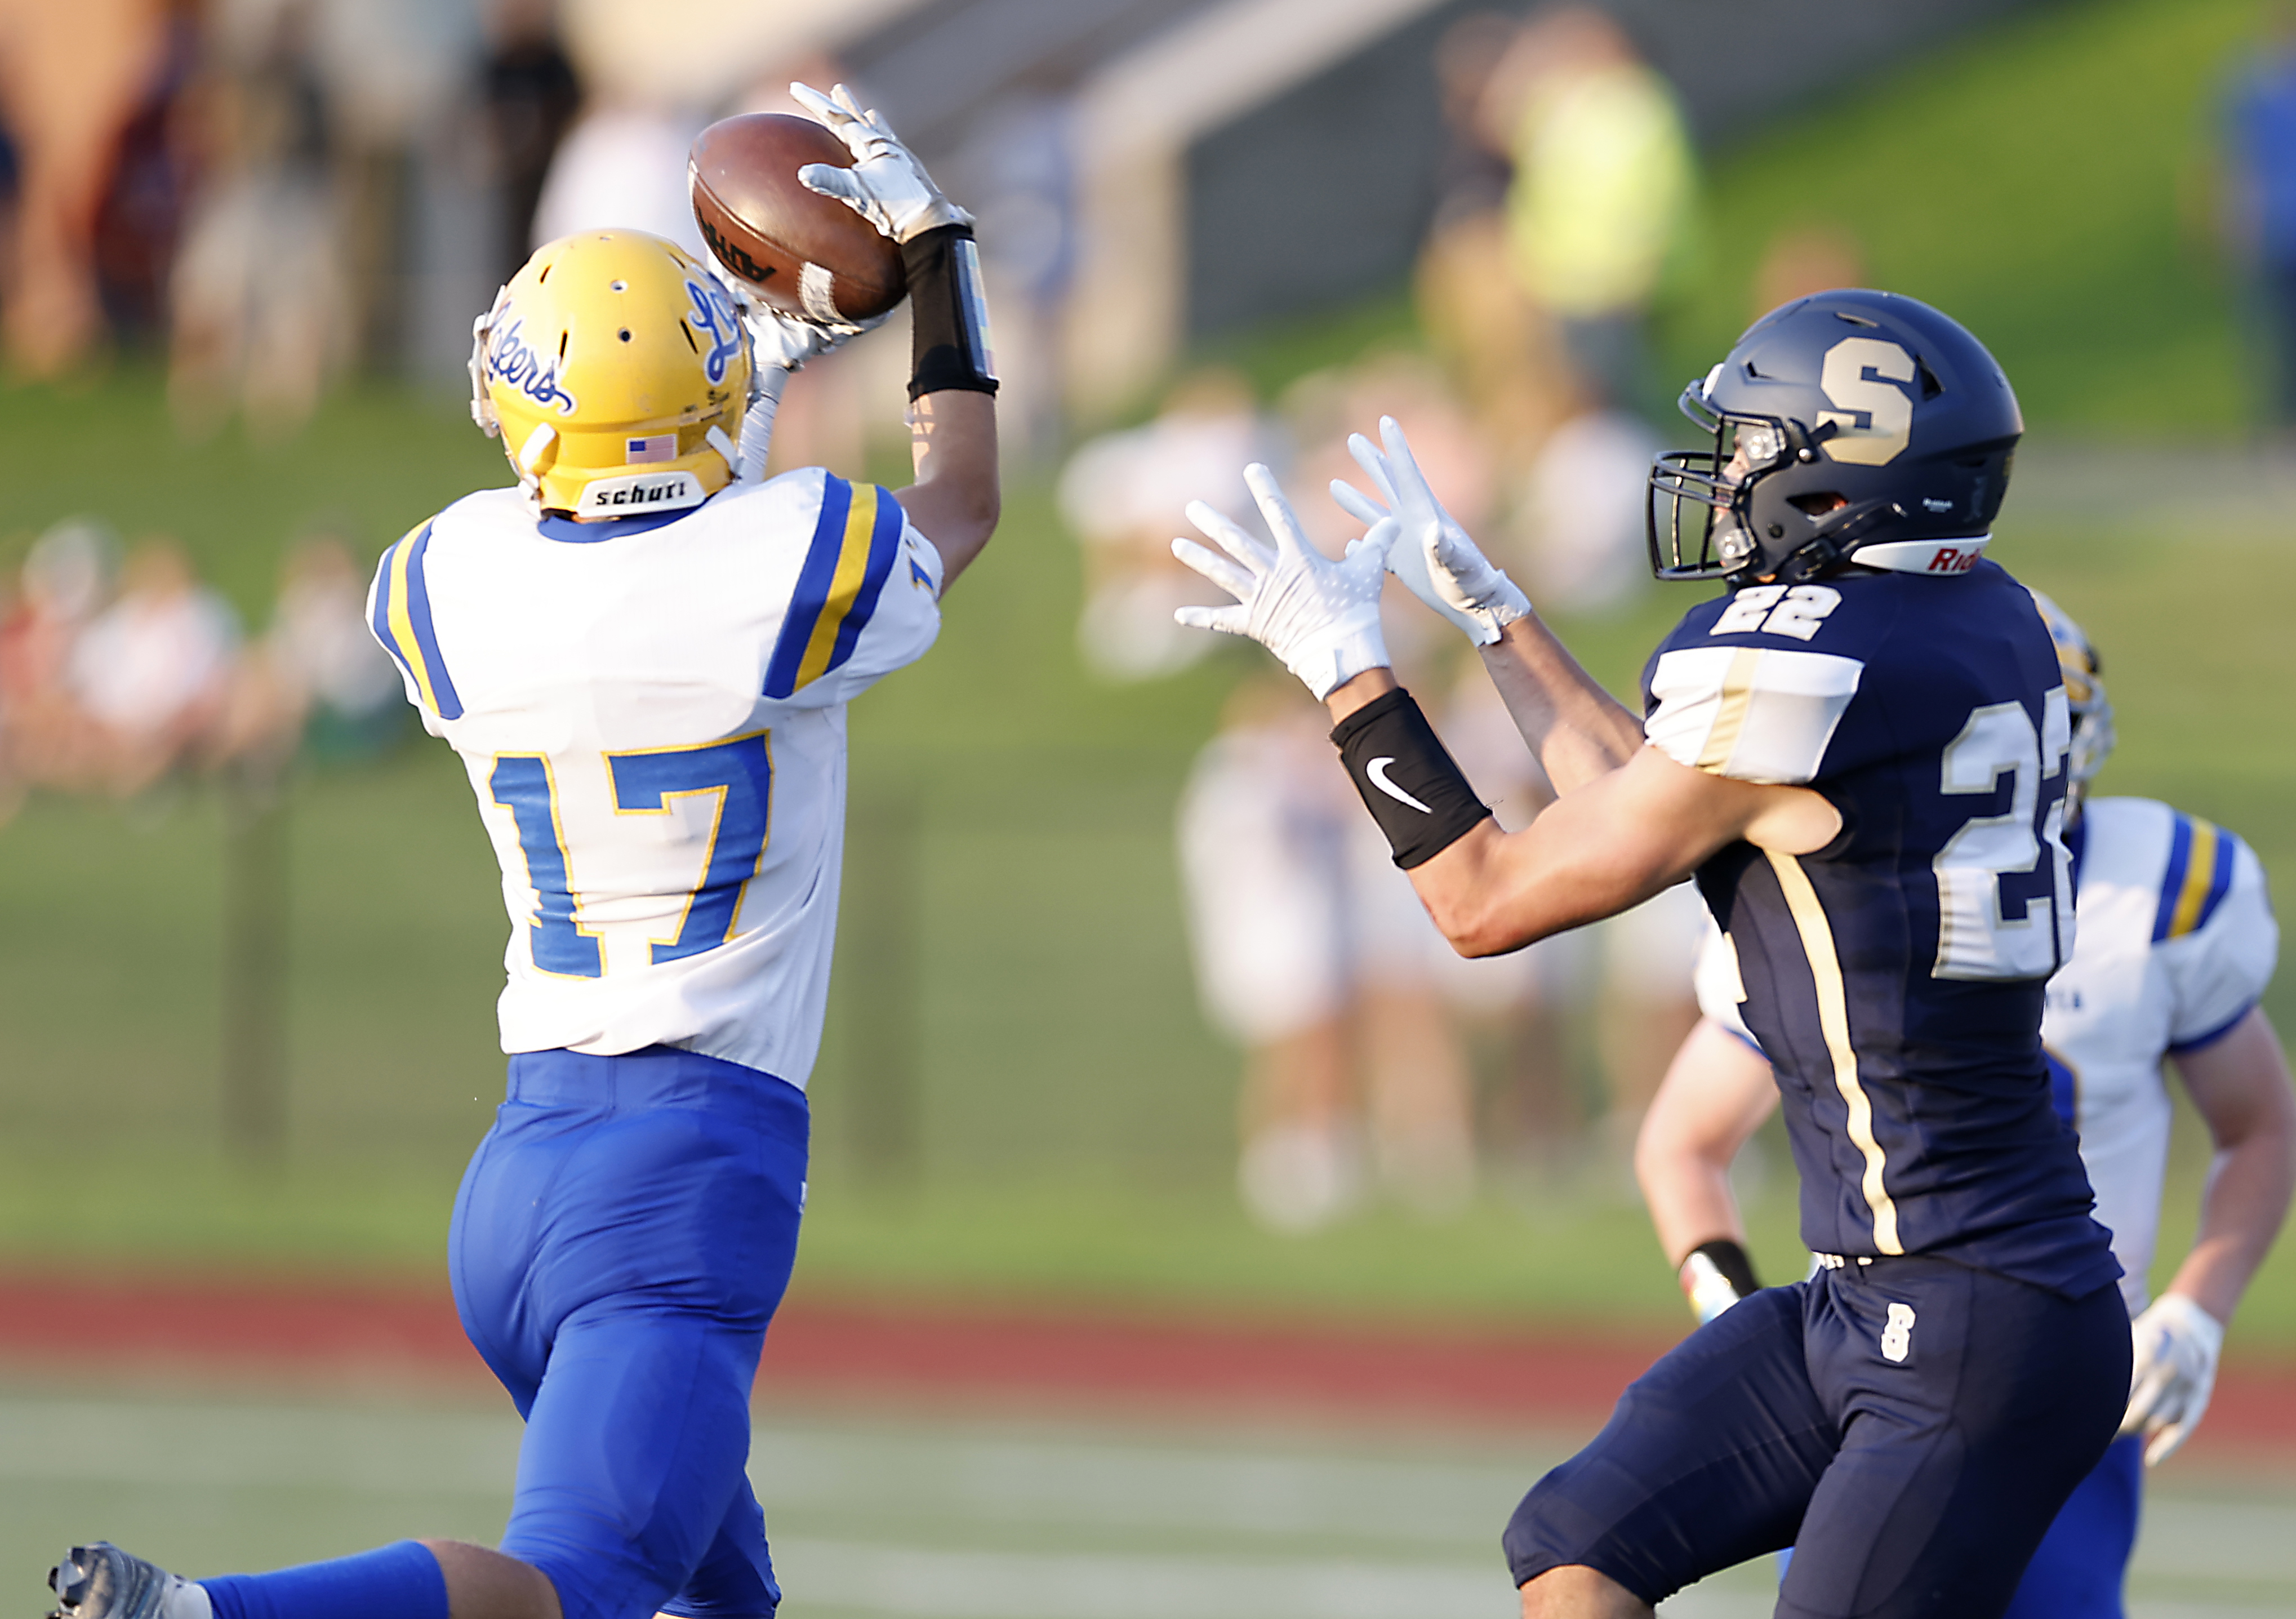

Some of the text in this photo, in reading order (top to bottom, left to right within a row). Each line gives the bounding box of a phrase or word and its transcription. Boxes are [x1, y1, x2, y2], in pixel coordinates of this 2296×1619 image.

[1817, 337, 1915, 466] S
[1709, 585, 1842, 641] 22
[487, 728, 774, 980] 17
